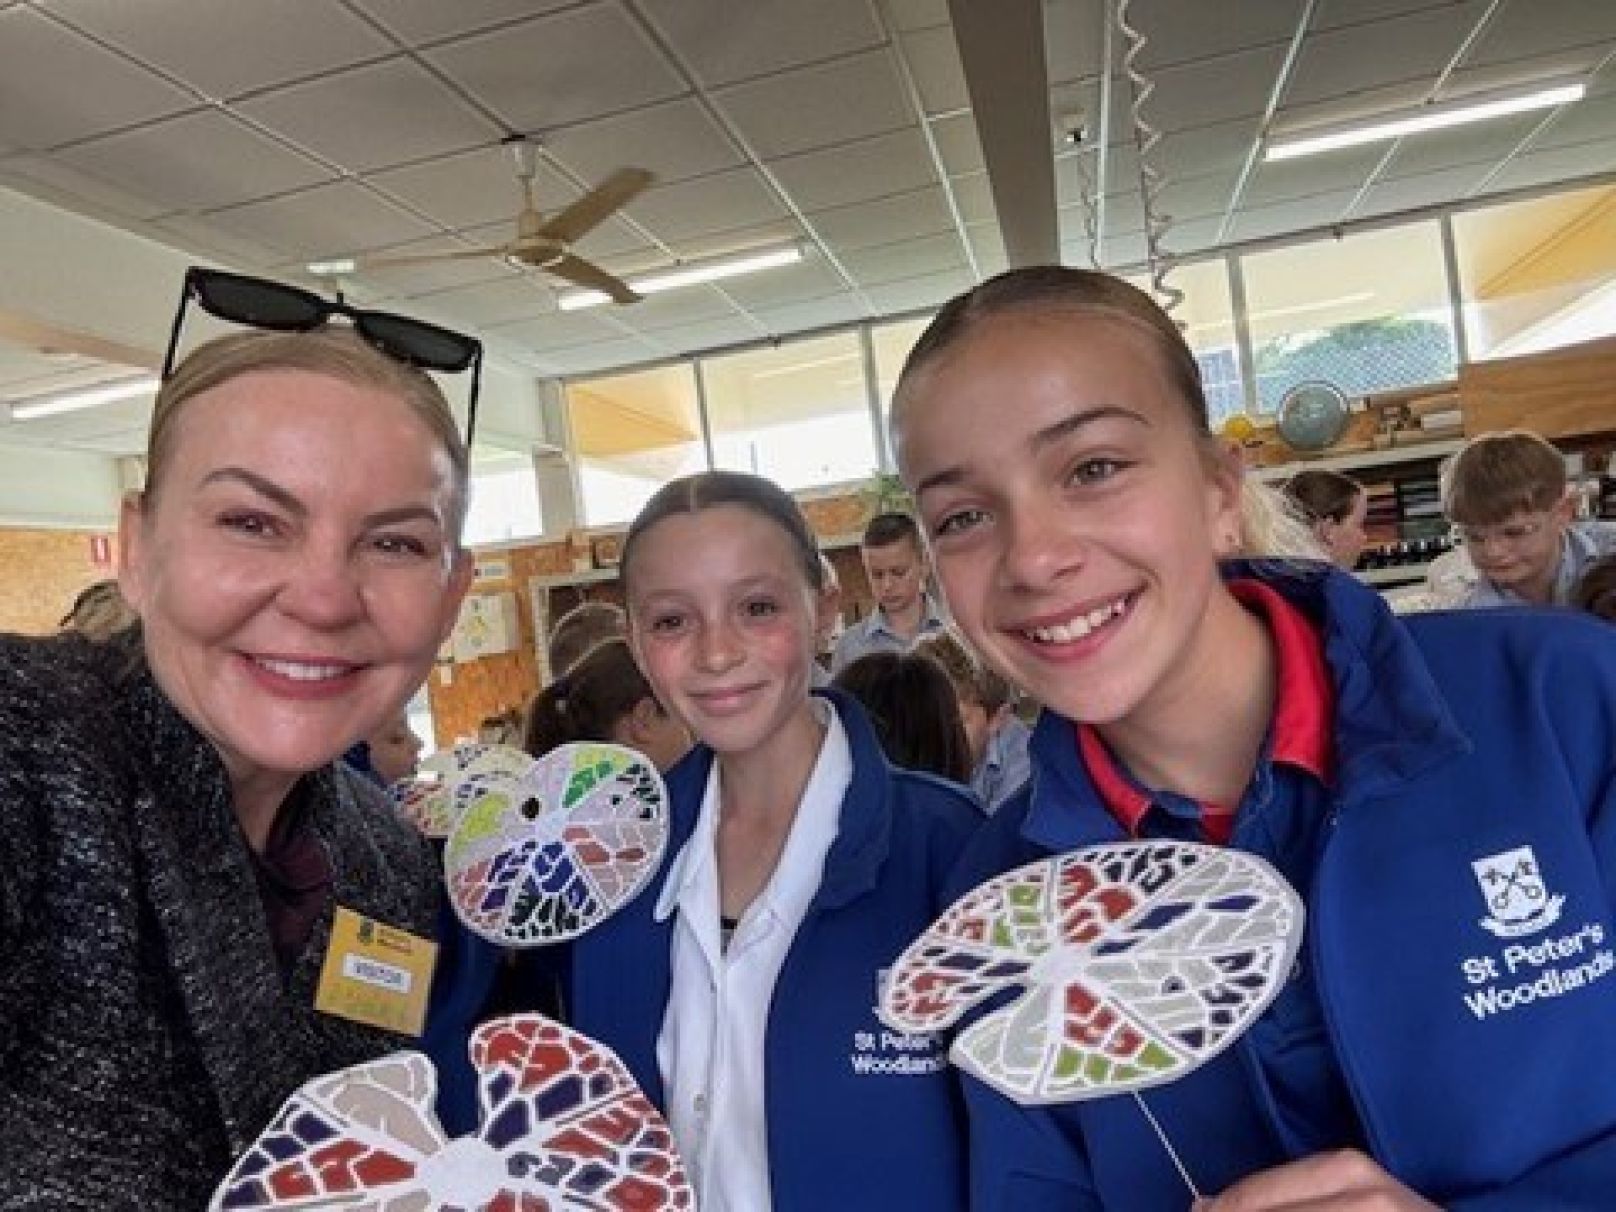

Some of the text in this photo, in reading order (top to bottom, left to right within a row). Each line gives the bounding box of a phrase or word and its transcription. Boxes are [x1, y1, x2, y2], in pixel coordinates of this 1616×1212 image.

[1461, 923, 1603, 985] St Peter's
[854, 1031, 876, 1051] St
